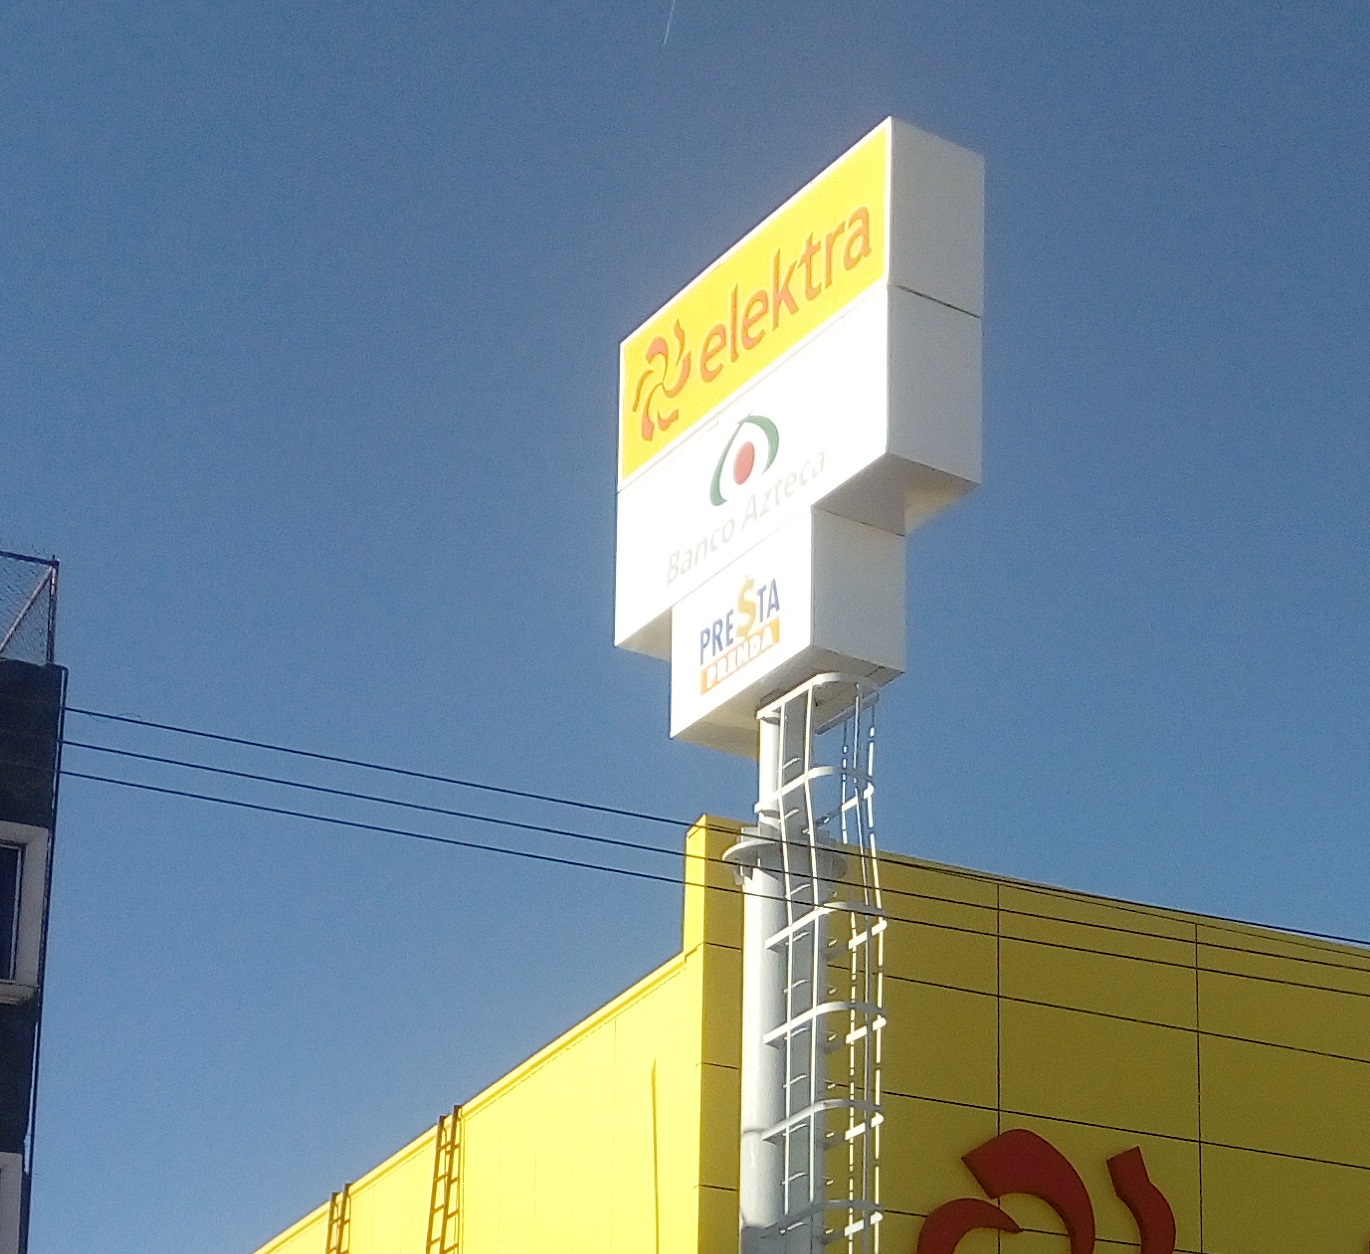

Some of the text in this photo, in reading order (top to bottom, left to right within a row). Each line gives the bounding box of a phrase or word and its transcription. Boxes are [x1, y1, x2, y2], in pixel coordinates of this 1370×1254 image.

[700, 206, 872, 383] elektra
[666, 449, 827, 585] Banco Azteca
